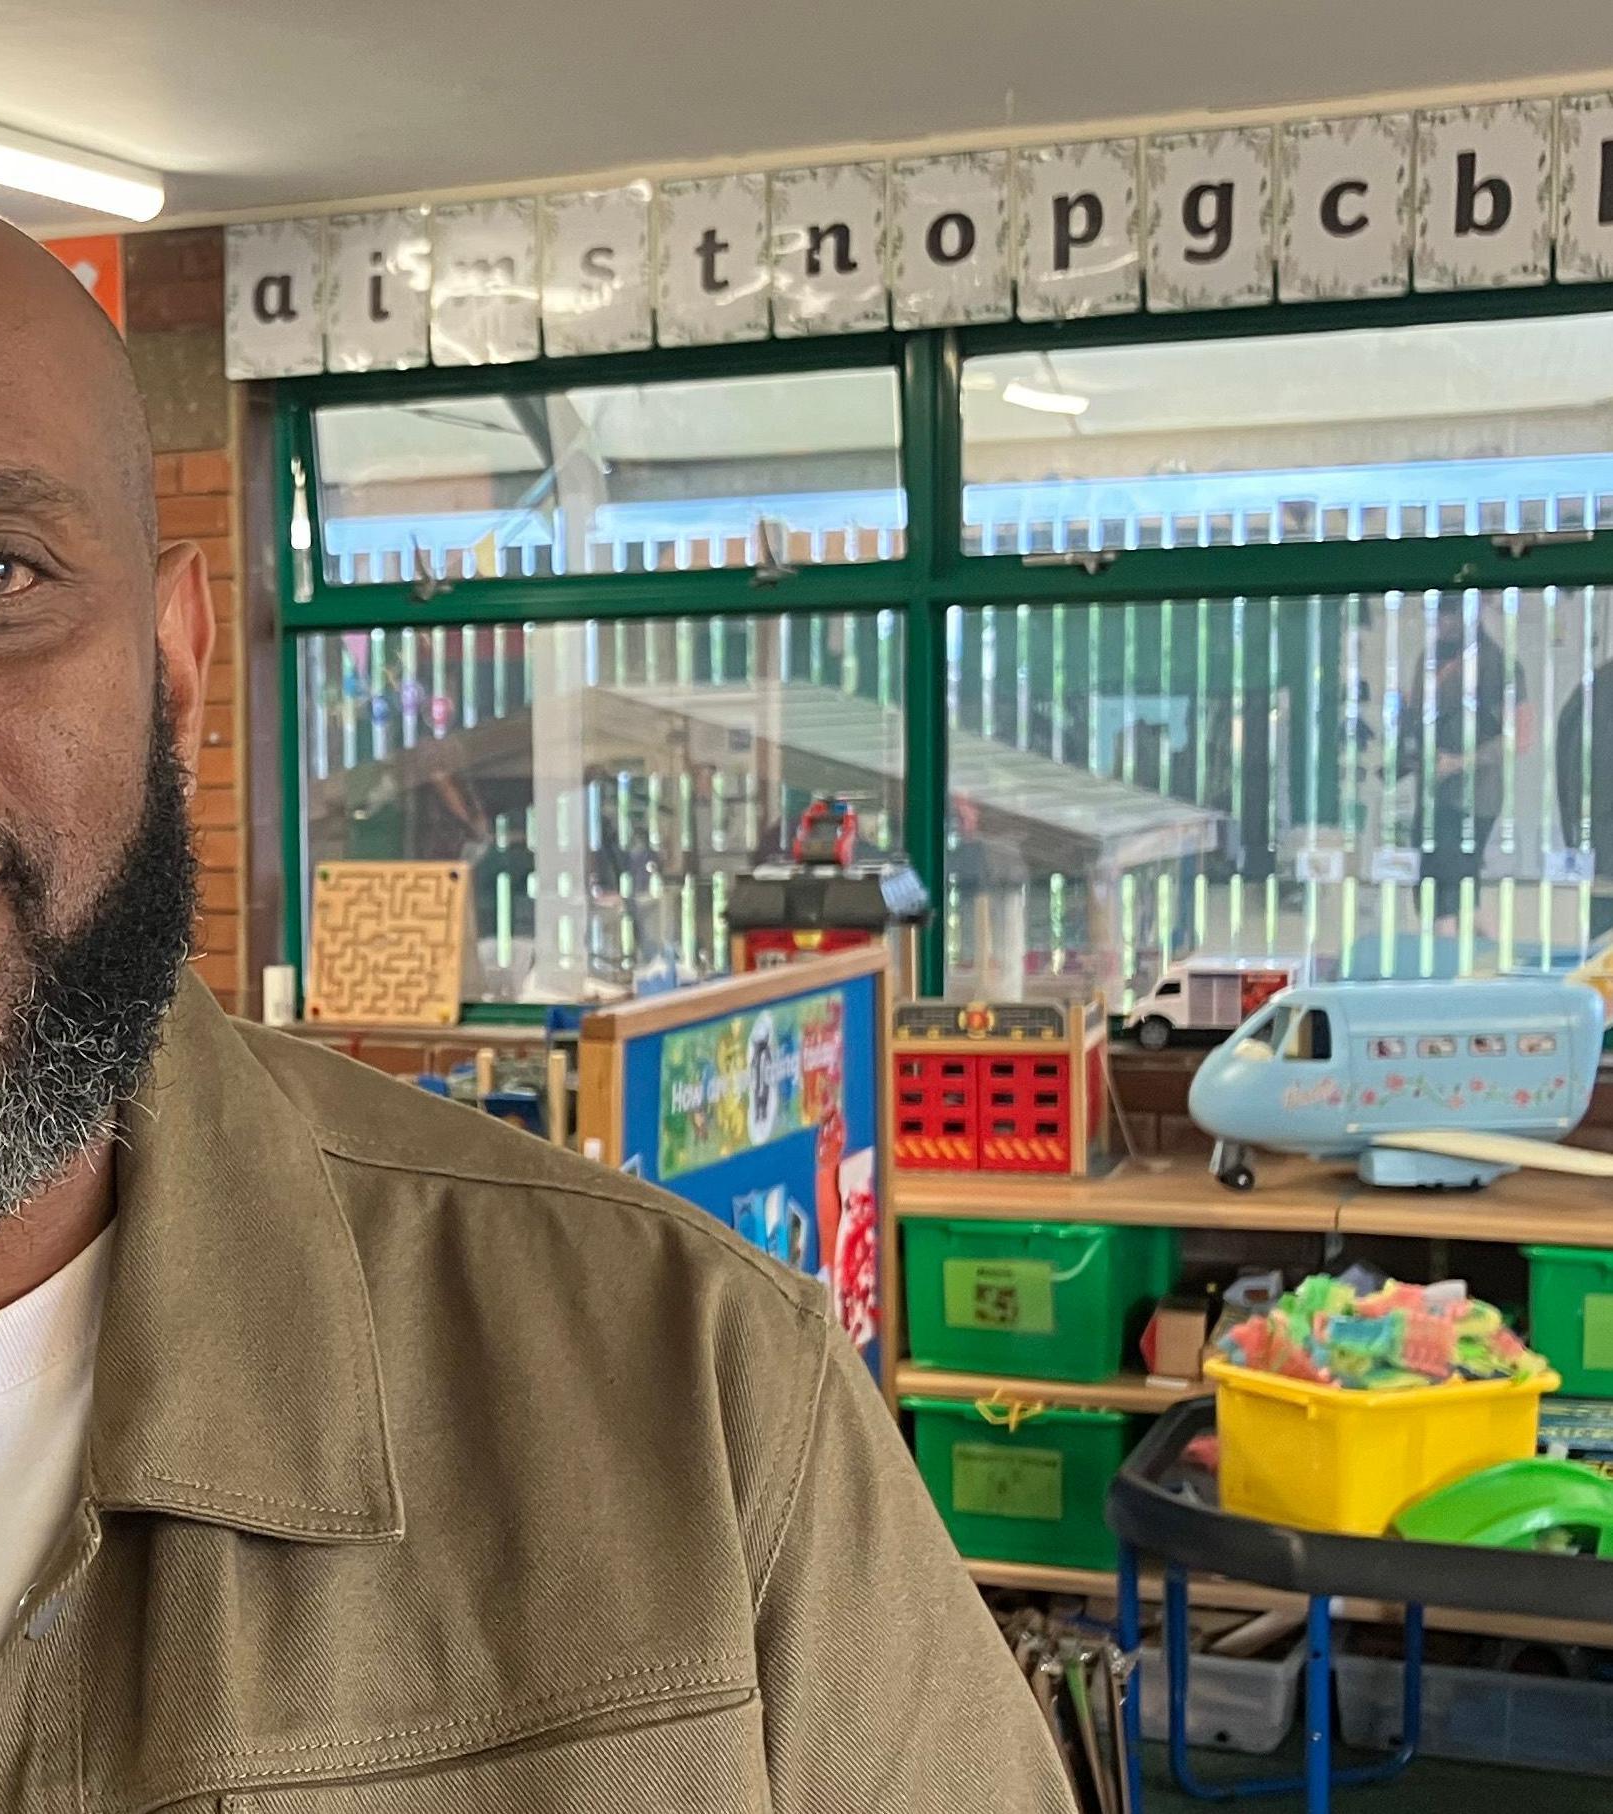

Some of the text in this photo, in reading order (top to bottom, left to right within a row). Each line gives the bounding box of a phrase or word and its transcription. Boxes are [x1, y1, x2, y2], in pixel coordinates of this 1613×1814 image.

[253, 273, 297, 325] a
[368, 250, 389, 322] i
[581, 246, 617, 292] s
[694, 228, 730, 294] t
[805, 220, 857, 277] n
[925, 211, 977, 267] o
[1051, 190, 1104, 271] p
[1182, 181, 1235, 265] g
[1319, 178, 1370, 238] c
[1453, 149, 1513, 237] b
